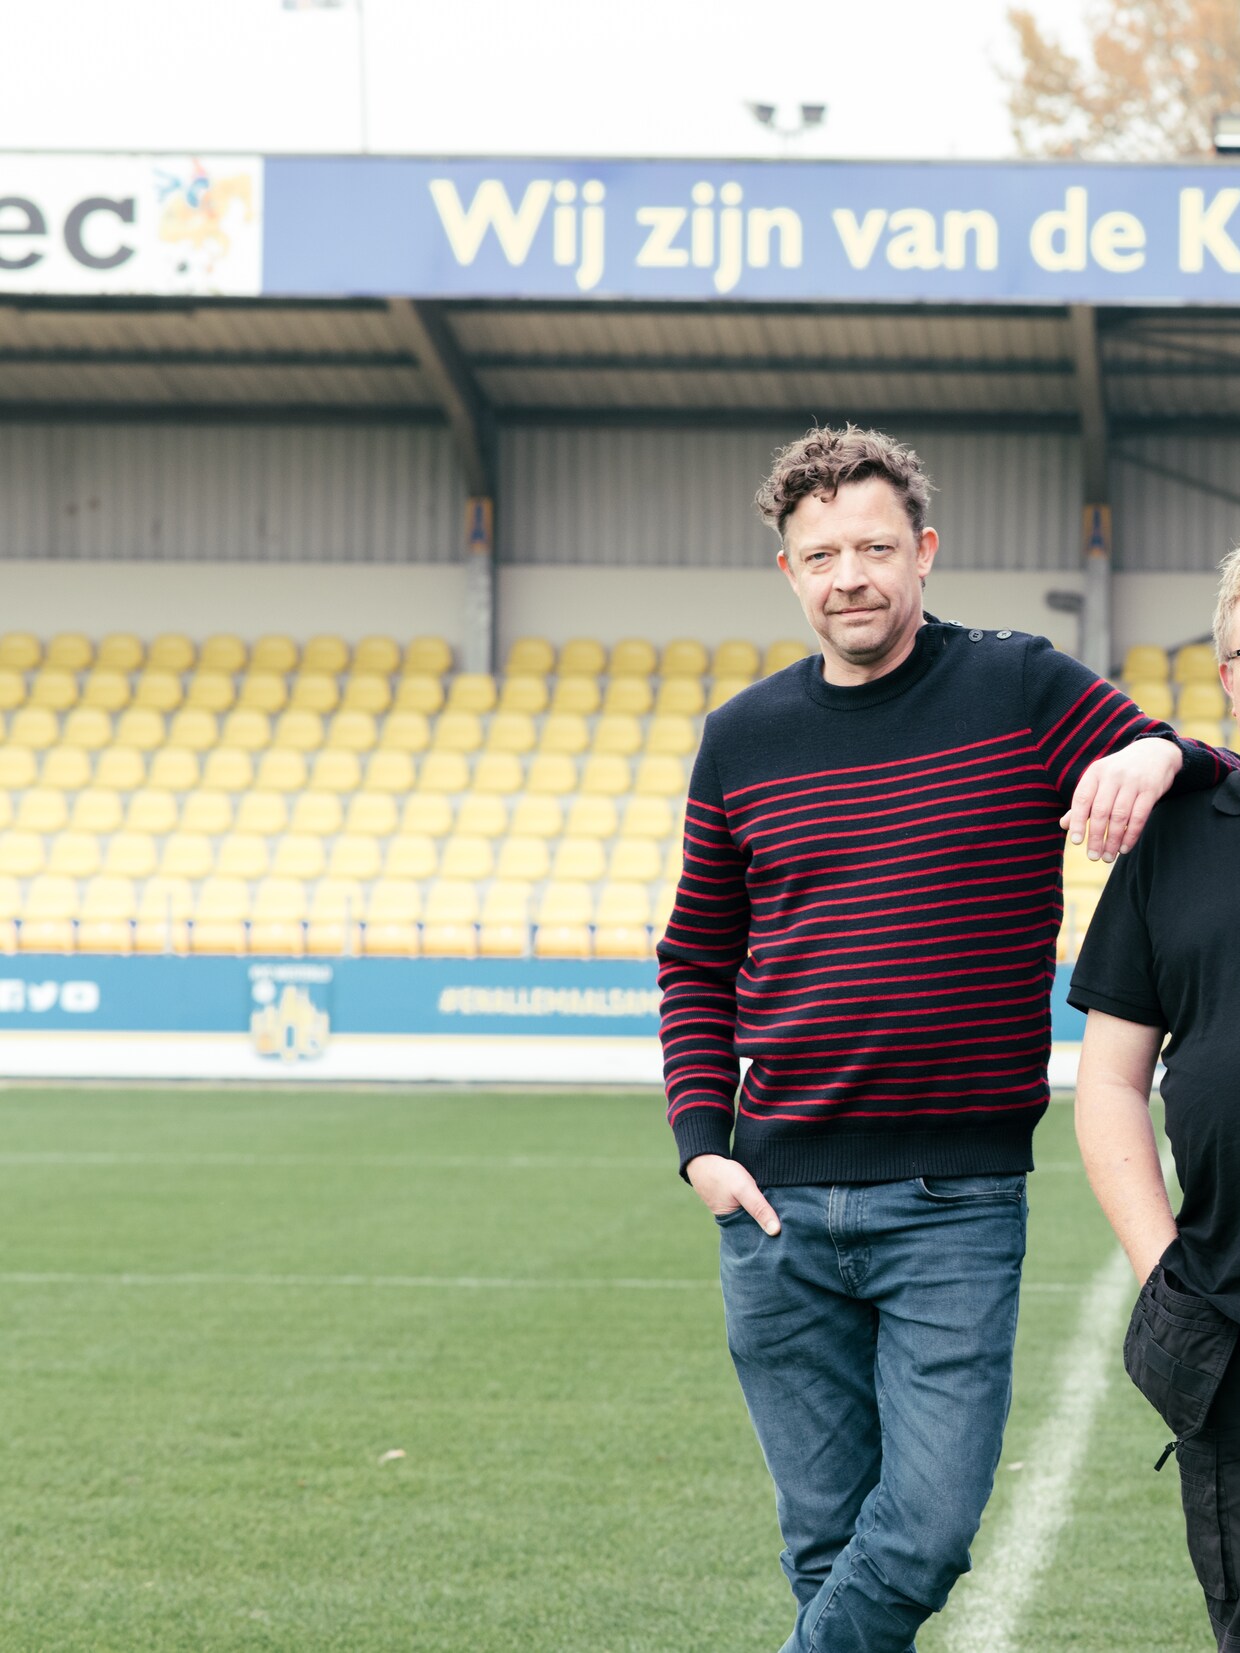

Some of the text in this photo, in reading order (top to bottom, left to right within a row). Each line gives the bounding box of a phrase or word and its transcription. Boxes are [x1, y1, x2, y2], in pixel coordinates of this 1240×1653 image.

[429, 179, 606, 292] Wij
[635, 181, 804, 295] zijn
[831, 207, 999, 272] van
[1029, 186, 1147, 273] de
